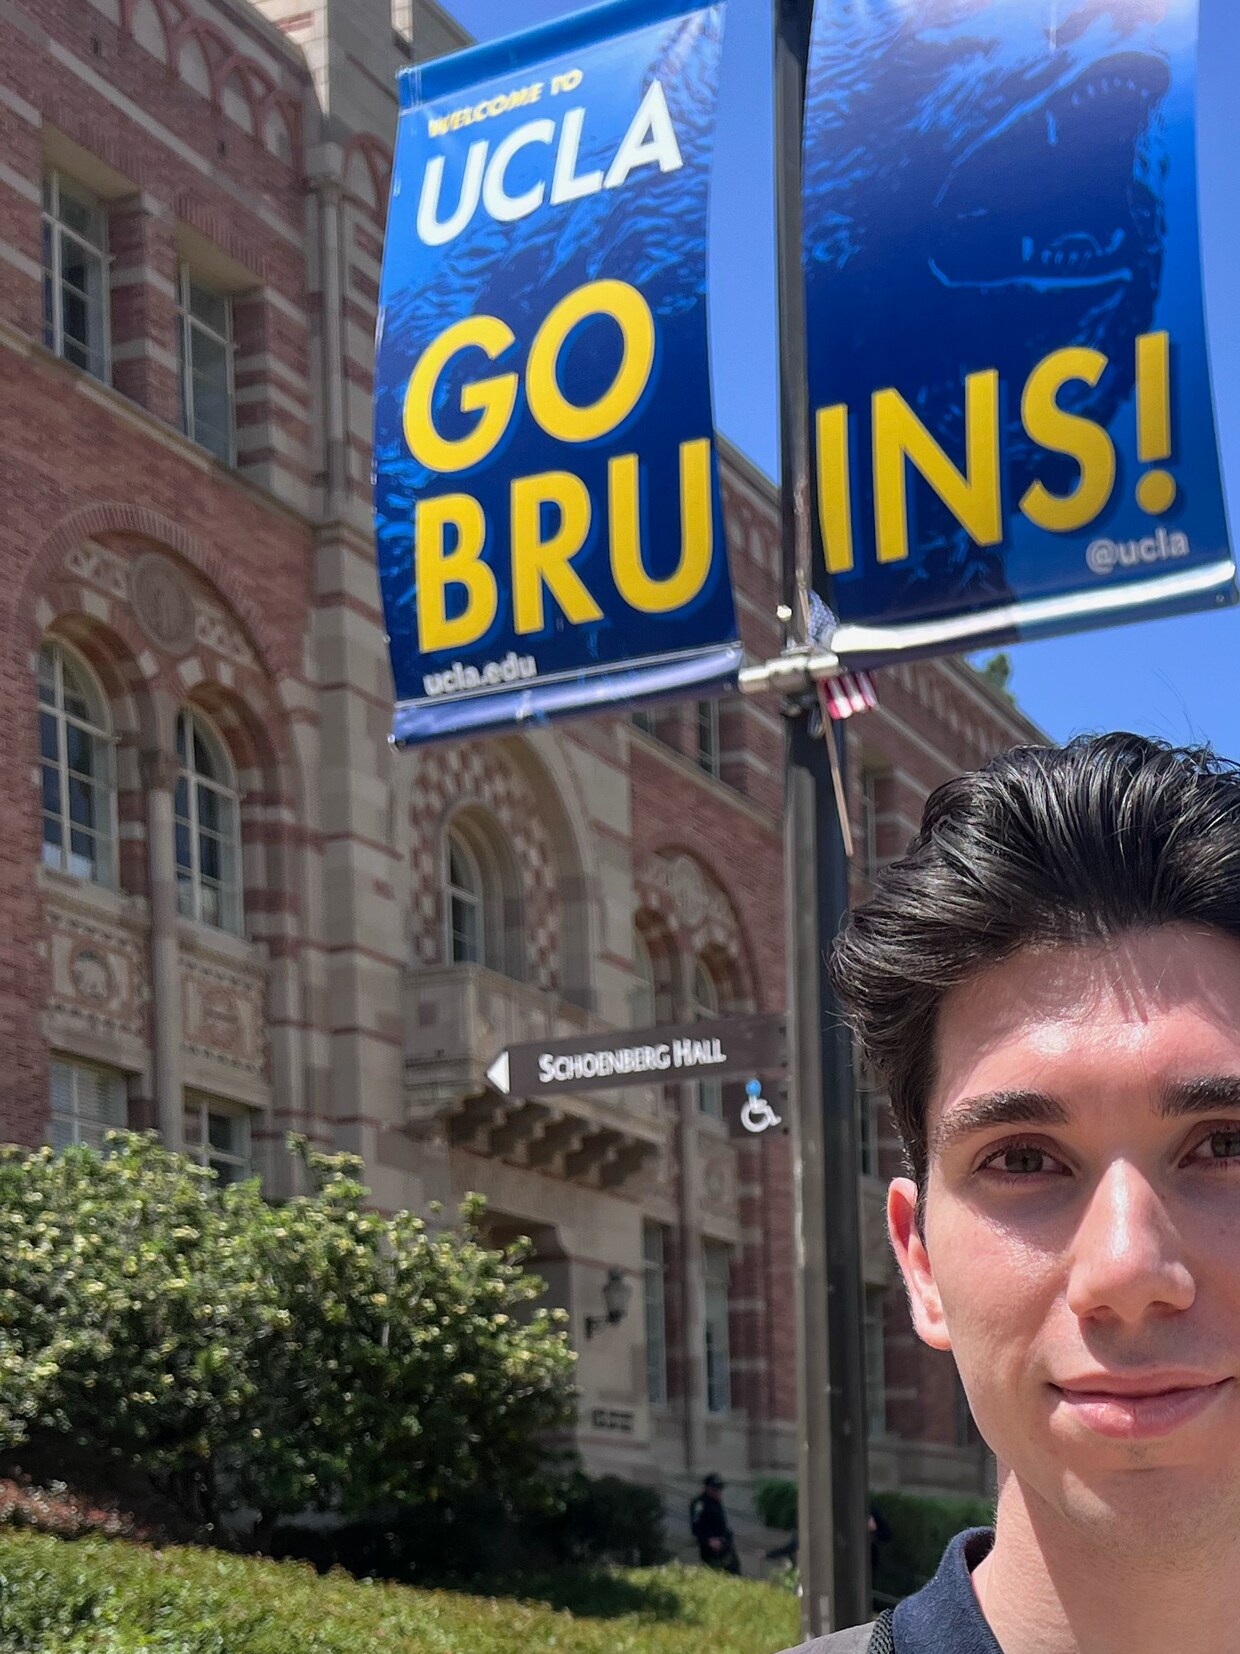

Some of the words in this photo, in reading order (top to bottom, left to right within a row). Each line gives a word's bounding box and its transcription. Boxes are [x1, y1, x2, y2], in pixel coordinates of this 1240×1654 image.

[416, 78, 683, 247] UCLA
[428, 82, 545, 138] WELCOME
[550, 68, 583, 96] TO
[402, 279, 656, 473] GO
[816, 331, 1177, 575] INS!
[415, 439, 713, 655] BRU
[1086, 525, 1190, 575] @ucla
[423, 651, 537, 696] ucla.edu
[538, 1043, 671, 1083] SCHOENBERG
[672, 1037, 727, 1068] HALL
